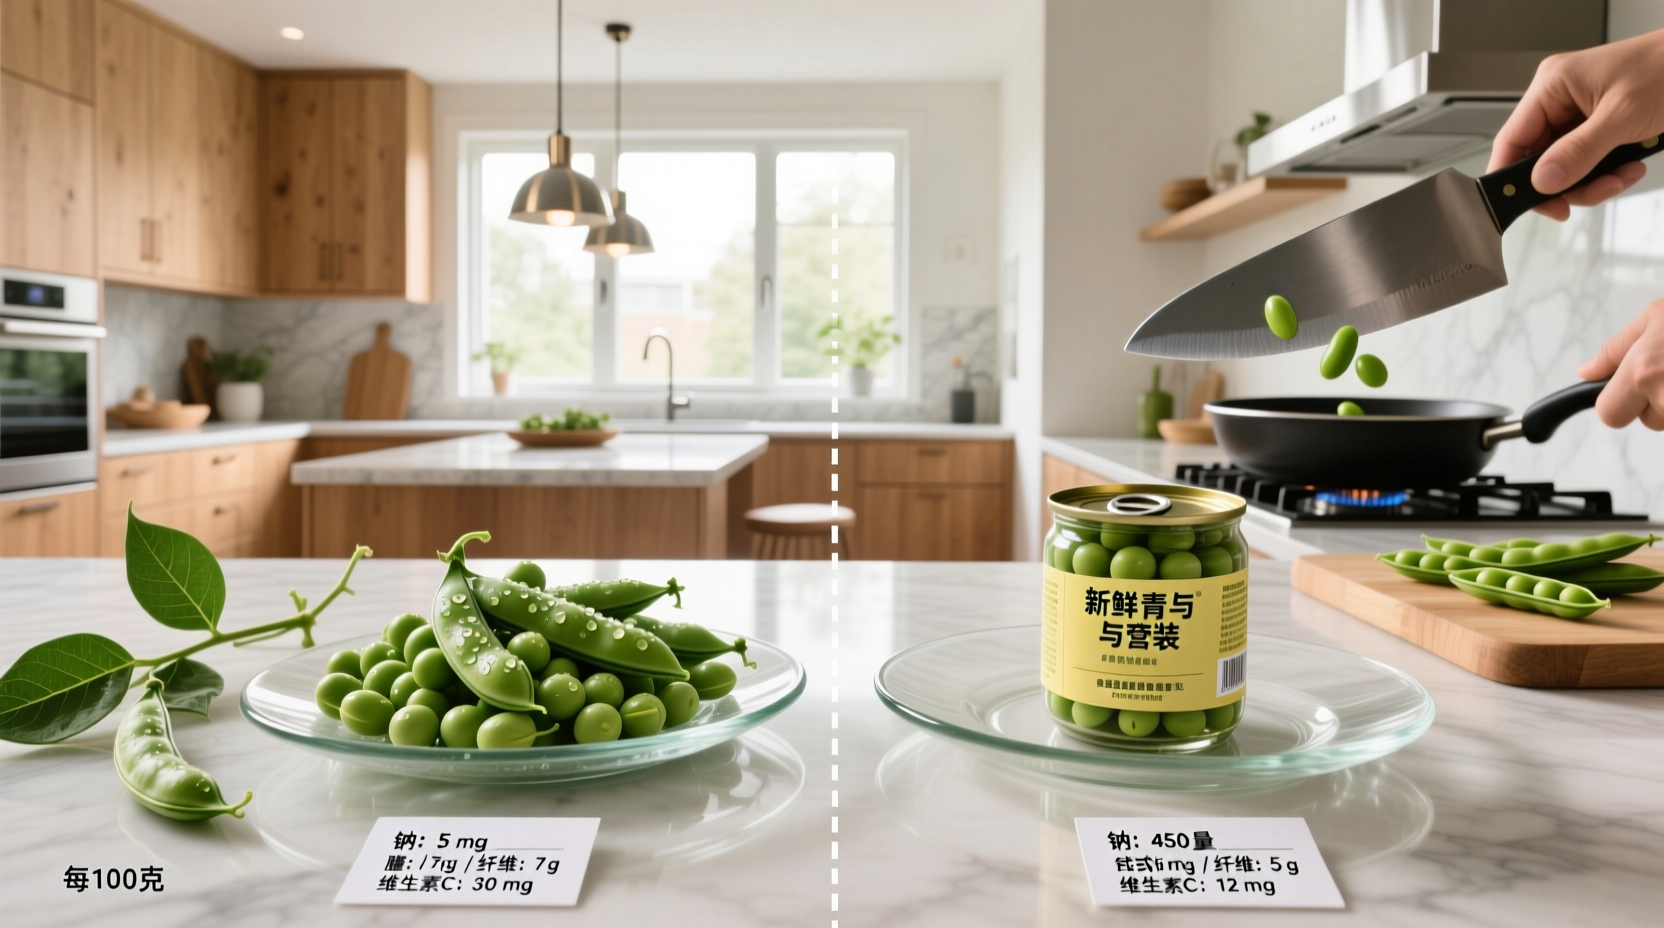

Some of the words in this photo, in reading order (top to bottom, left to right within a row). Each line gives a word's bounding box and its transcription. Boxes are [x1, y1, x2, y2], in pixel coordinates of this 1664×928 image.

[1085, 587, 1193, 620] 新鲜青与
[456, 838, 487, 852] mg
[473, 877, 497, 891] 30
[503, 881, 533, 895] mg
[1217, 878, 1239, 892] 12
[1245, 881, 1275, 896] mg
